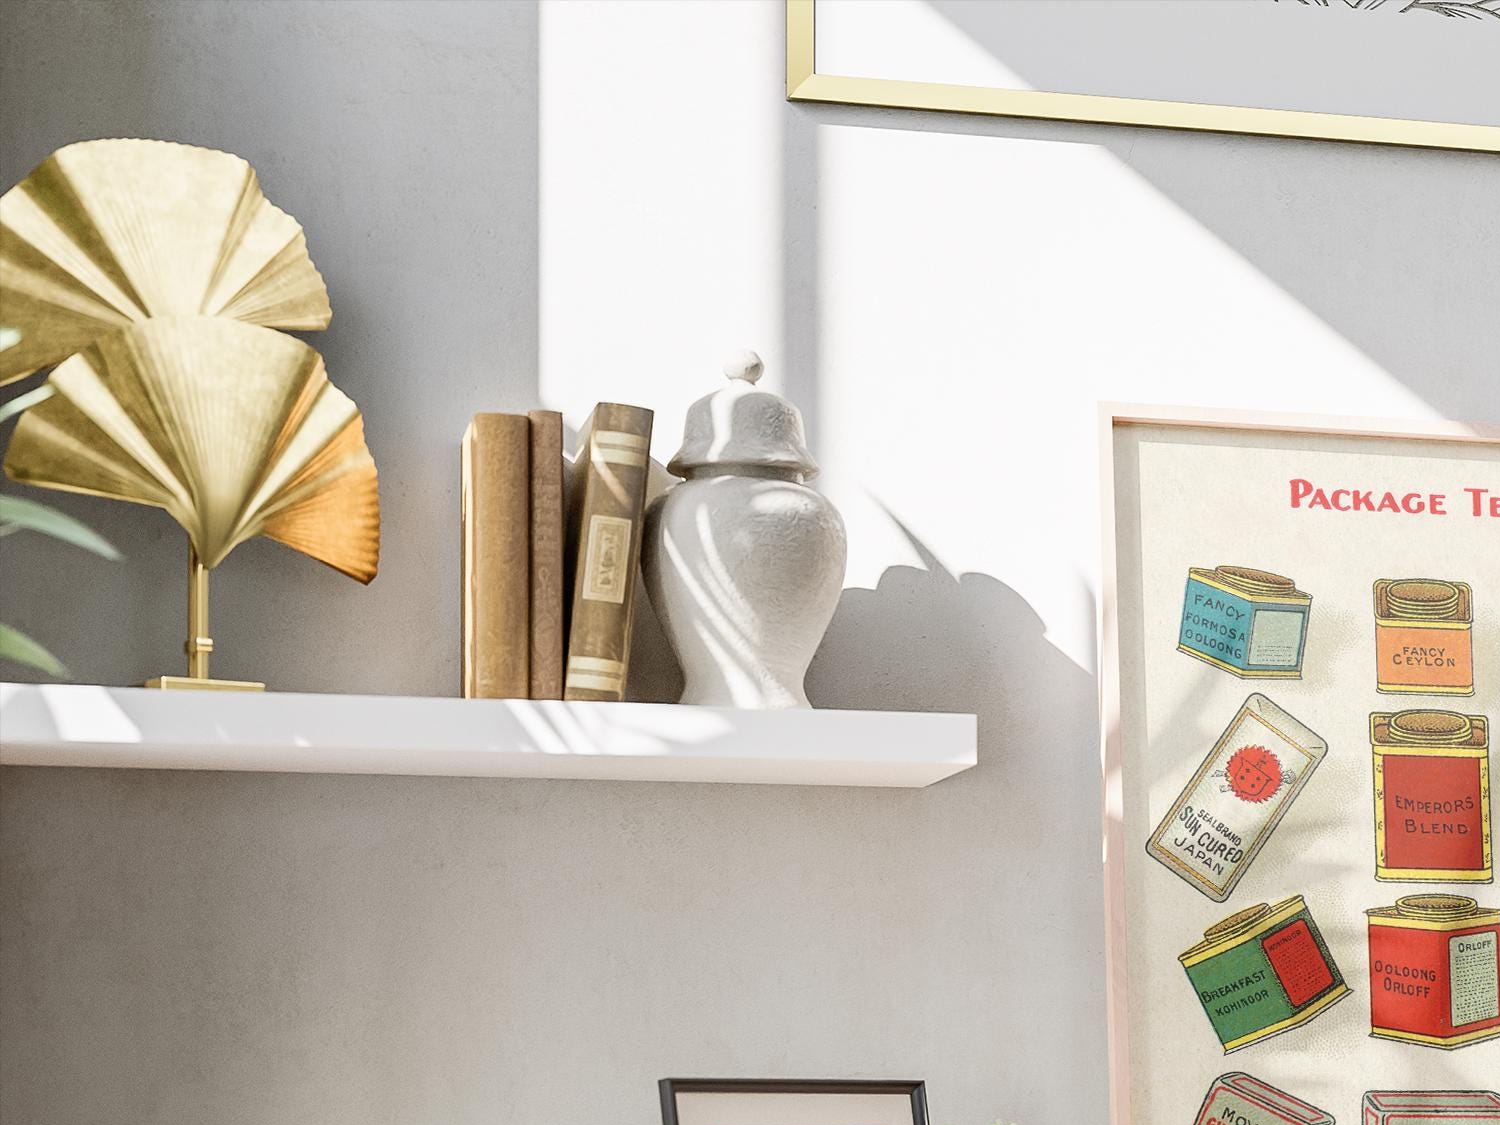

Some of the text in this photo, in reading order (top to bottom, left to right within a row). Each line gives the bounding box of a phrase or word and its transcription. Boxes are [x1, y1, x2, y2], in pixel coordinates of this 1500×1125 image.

[1289, 479, 1446, 515] PACKAGE
[1194, 594, 1245, 620] FANCY
[1186, 613, 1245, 642] FORMOSA
[1185, 629, 1242, 659] OOLOONG
[1403, 647, 1445, 658] FANCY
[1393, 654, 1455, 667] CEYLON
[1396, 796, 1474, 814] EMPERORS
[1180, 806, 1244, 864] SUN CURED
[1405, 819, 1468, 834] BLEND
[1174, 837, 1224, 875] JAPAN
[1458, 940, 1491, 953] ORLOFF
[1374, 961, 1436, 981] OOLOONG
[1202, 970, 1266, 1003] BREAKFAST
[1384, 977, 1430, 998] ORLOFF
